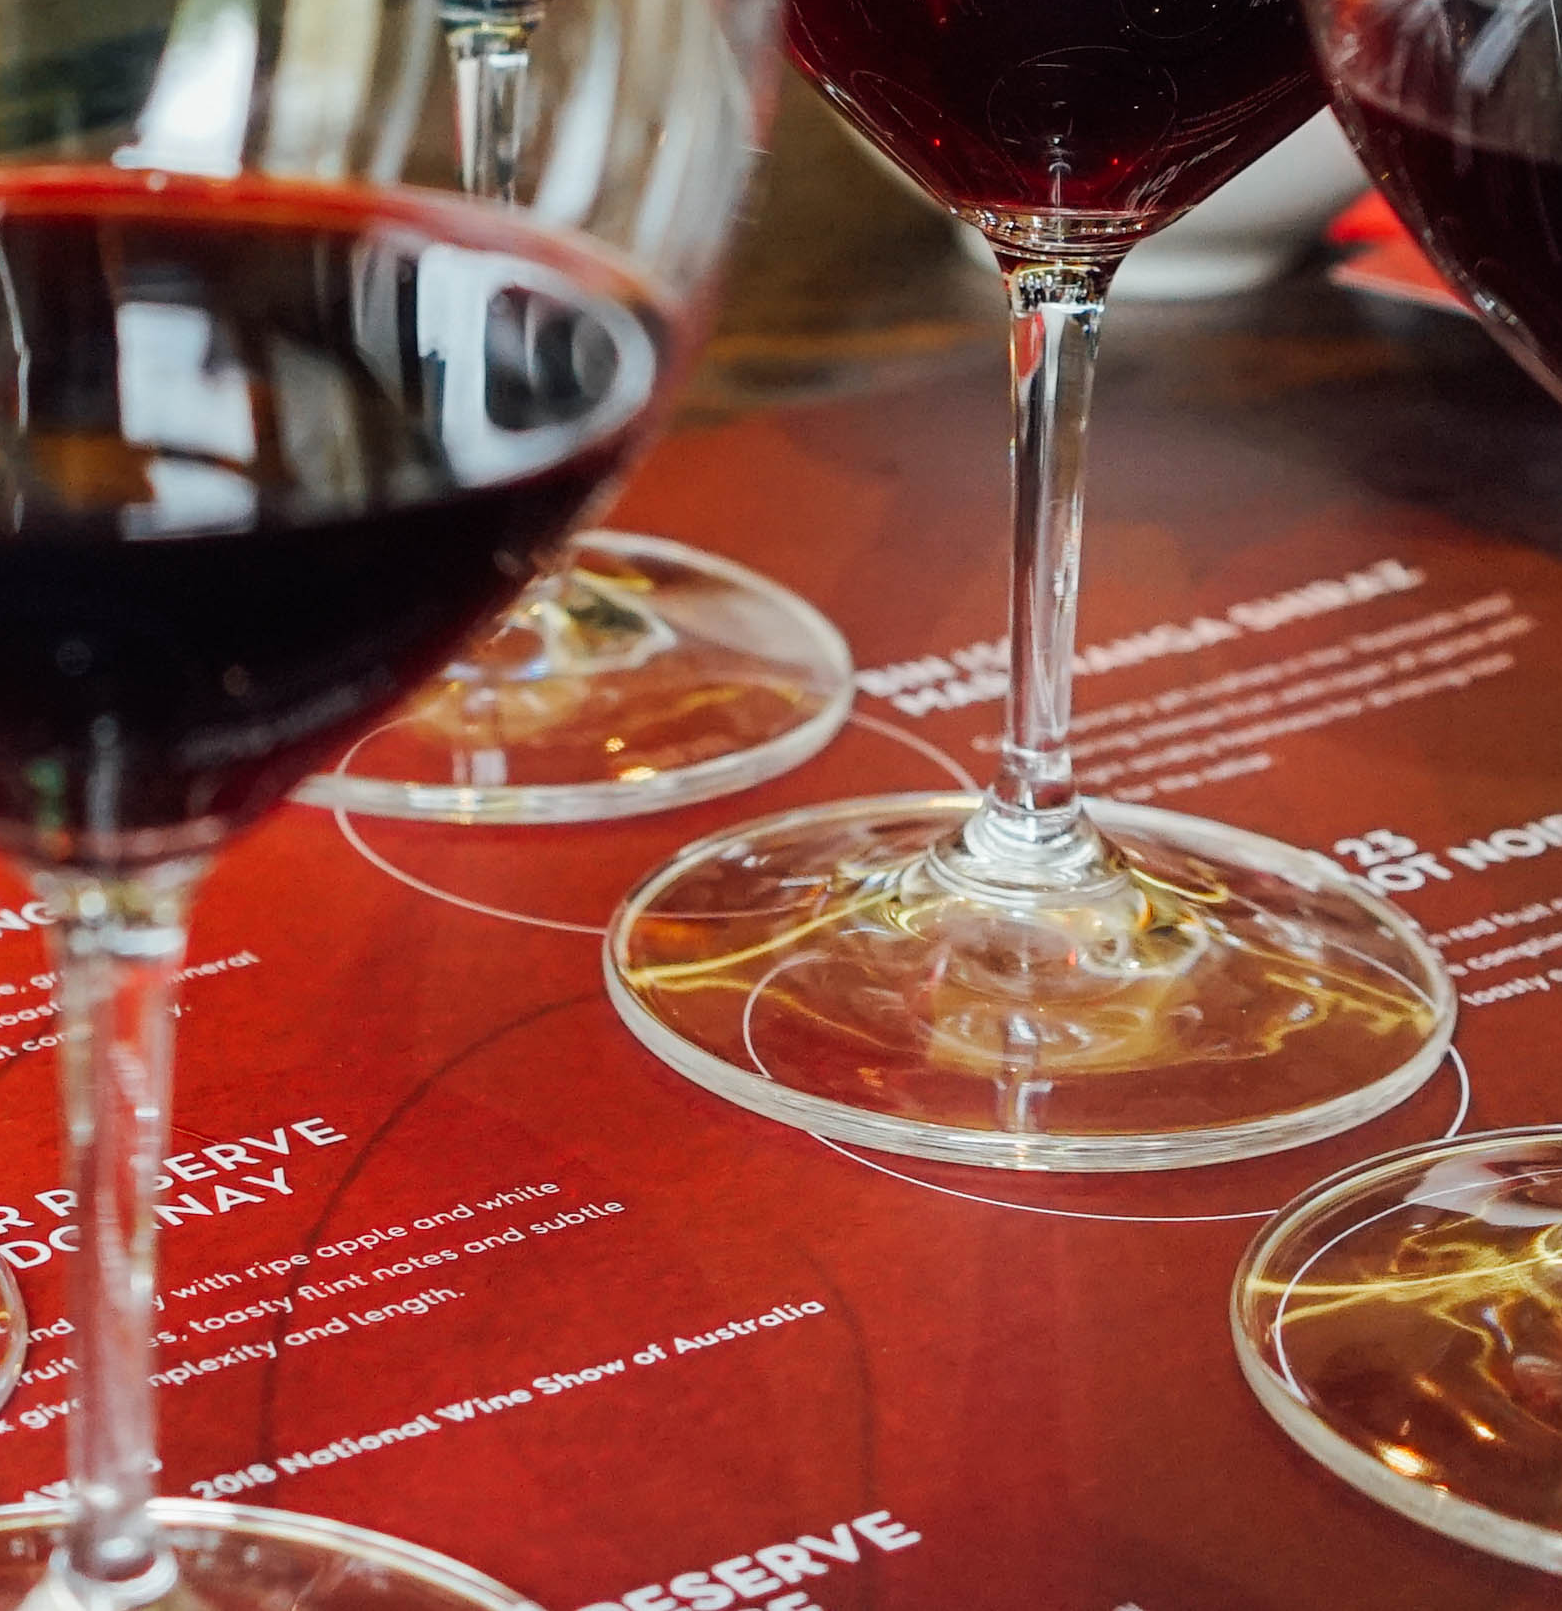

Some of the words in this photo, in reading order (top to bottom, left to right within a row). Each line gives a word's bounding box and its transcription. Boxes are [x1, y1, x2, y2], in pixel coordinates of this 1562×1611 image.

[19, 1357, 80, 1387] ruit
[189, 1292, 294, 1333] toasty
[298, 1274, 369, 1300] flint
[372, 1247, 458, 1280] notes
[464, 1227, 525, 1254] and
[529, 1198, 624, 1235] subtle
[26, 1318, 76, 1343] nd
[171, 1274, 241, 1300] with
[245, 1252, 310, 1278] ripe
[316, 1224, 408, 1260] apple
[413, 1204, 475, 1230] and
[477, 1180, 560, 1212] white
[284, 1318, 349, 1346] and
[348, 1286, 465, 1326] length.
[190, 1464, 277, 1499] 2018
[277, 1412, 442, 1474] National
[435, 1387, 533, 1424] Wine
[532, 1358, 626, 1397] Show
[633, 1341, 668, 1368] of
[673, 1300, 825, 1355] Australia
[576, 1510, 922, 1611] ESERVE
